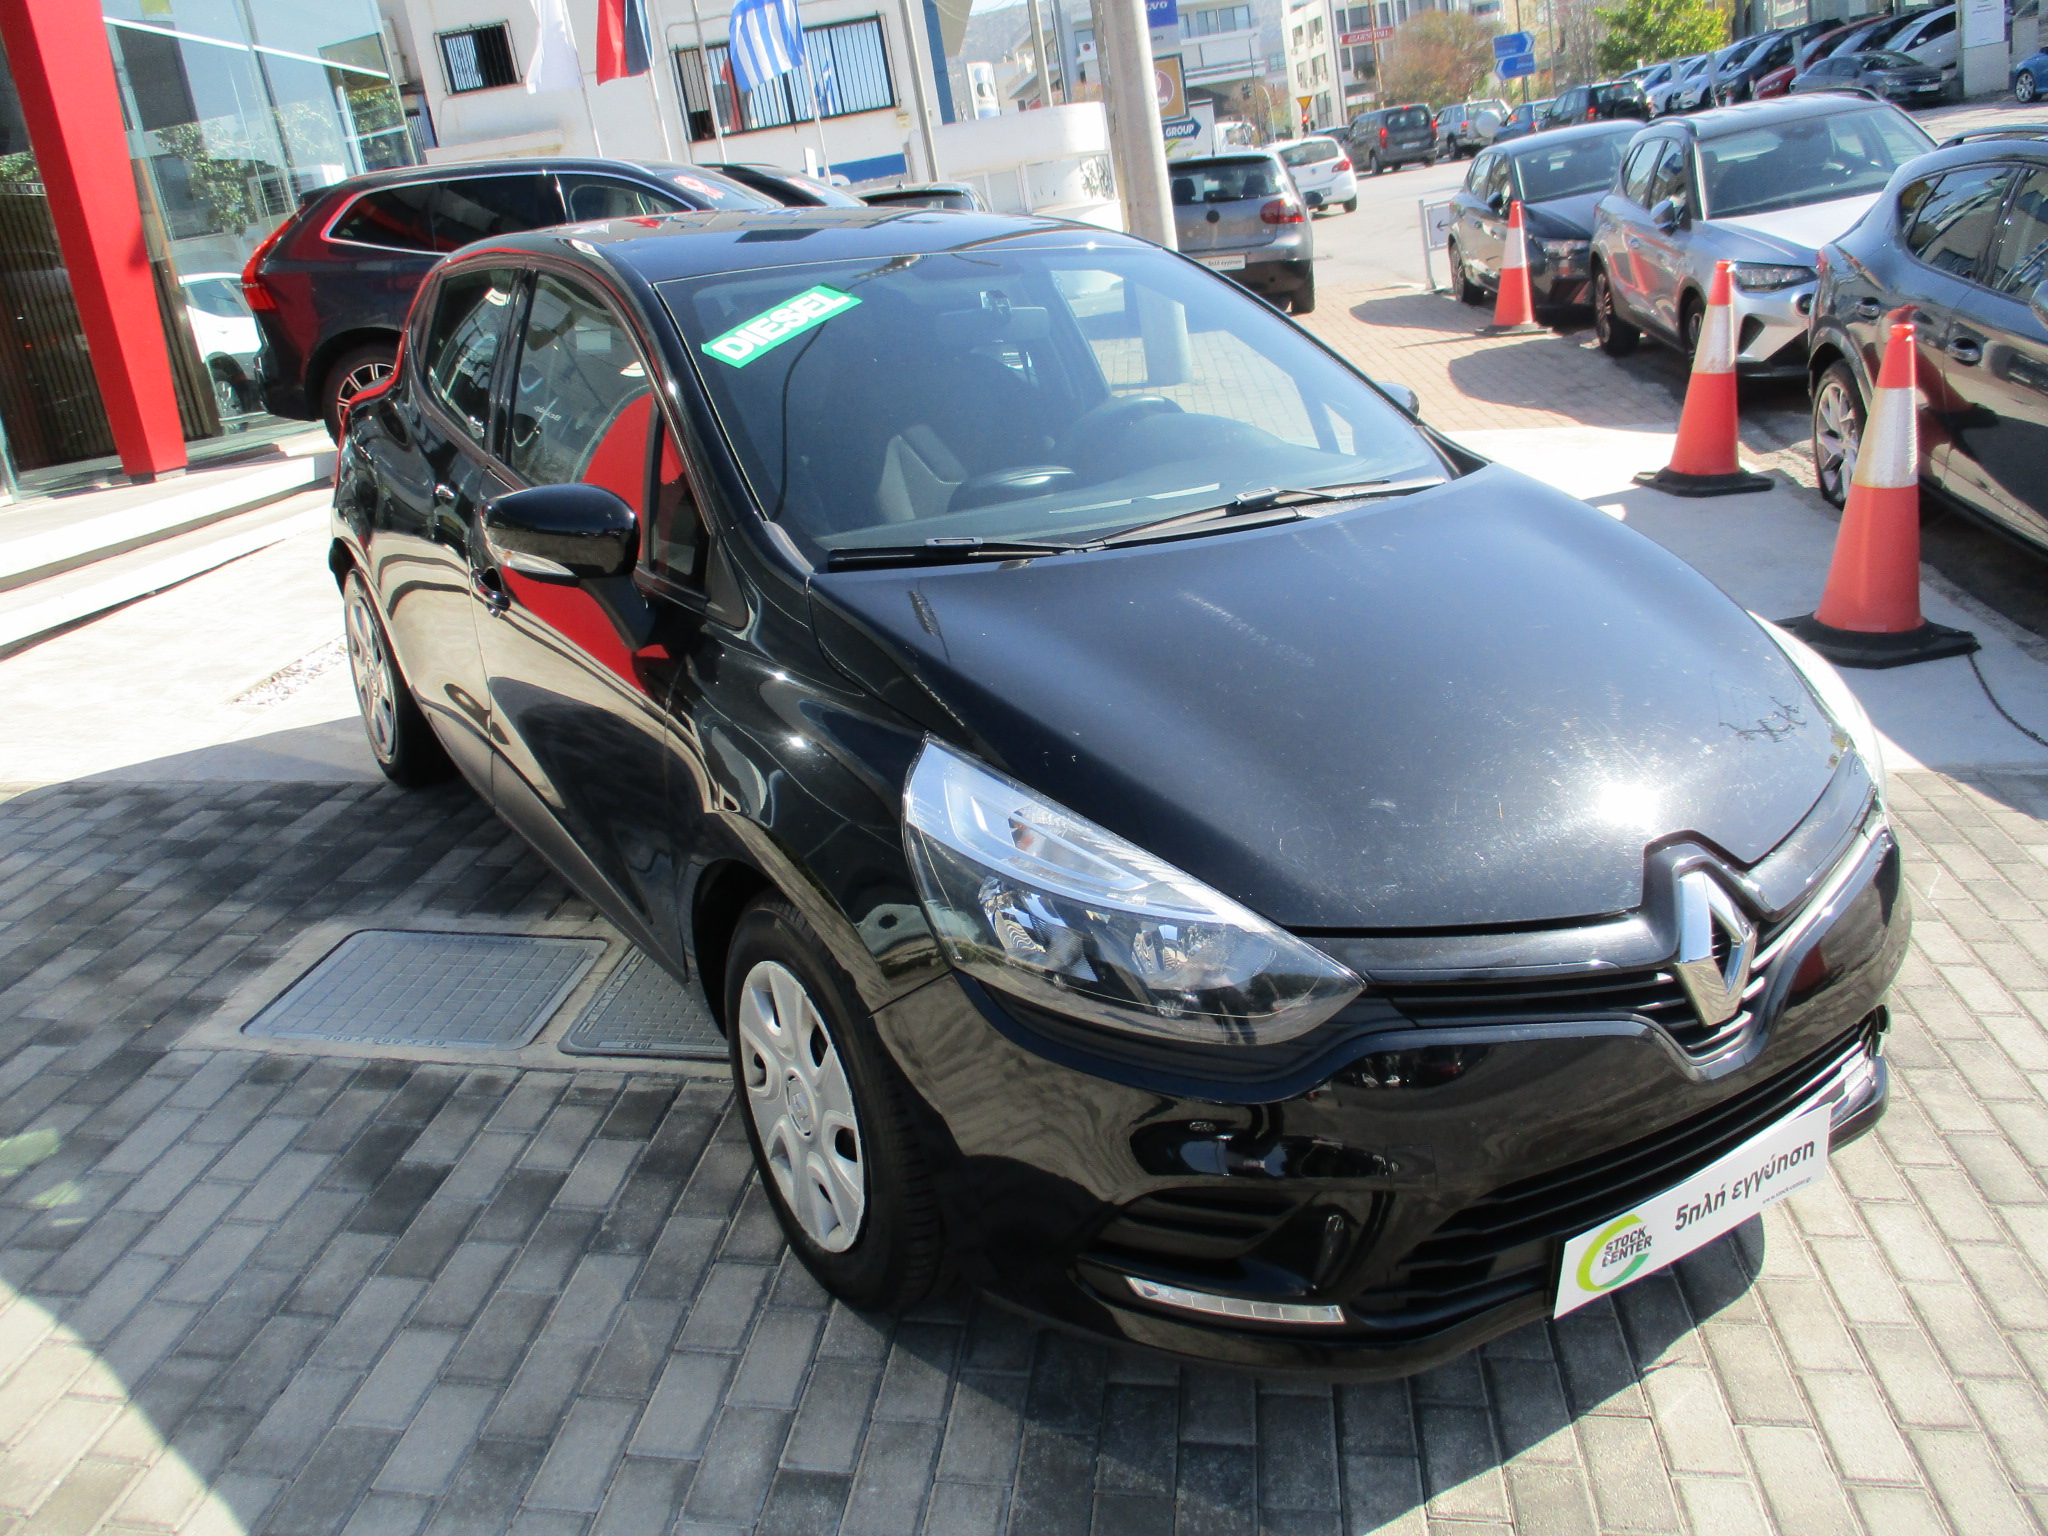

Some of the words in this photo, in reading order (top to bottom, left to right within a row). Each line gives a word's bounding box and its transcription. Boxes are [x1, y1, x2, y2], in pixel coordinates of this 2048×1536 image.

[1165, 124, 1195, 137] GROUP
[711, 292, 851, 361] DIESEL
[1675, 1183, 1727, 1231] 5πλή
[1601, 1235, 1653, 1268] CENTER
[1605, 1224, 1647, 1252] STOCK
